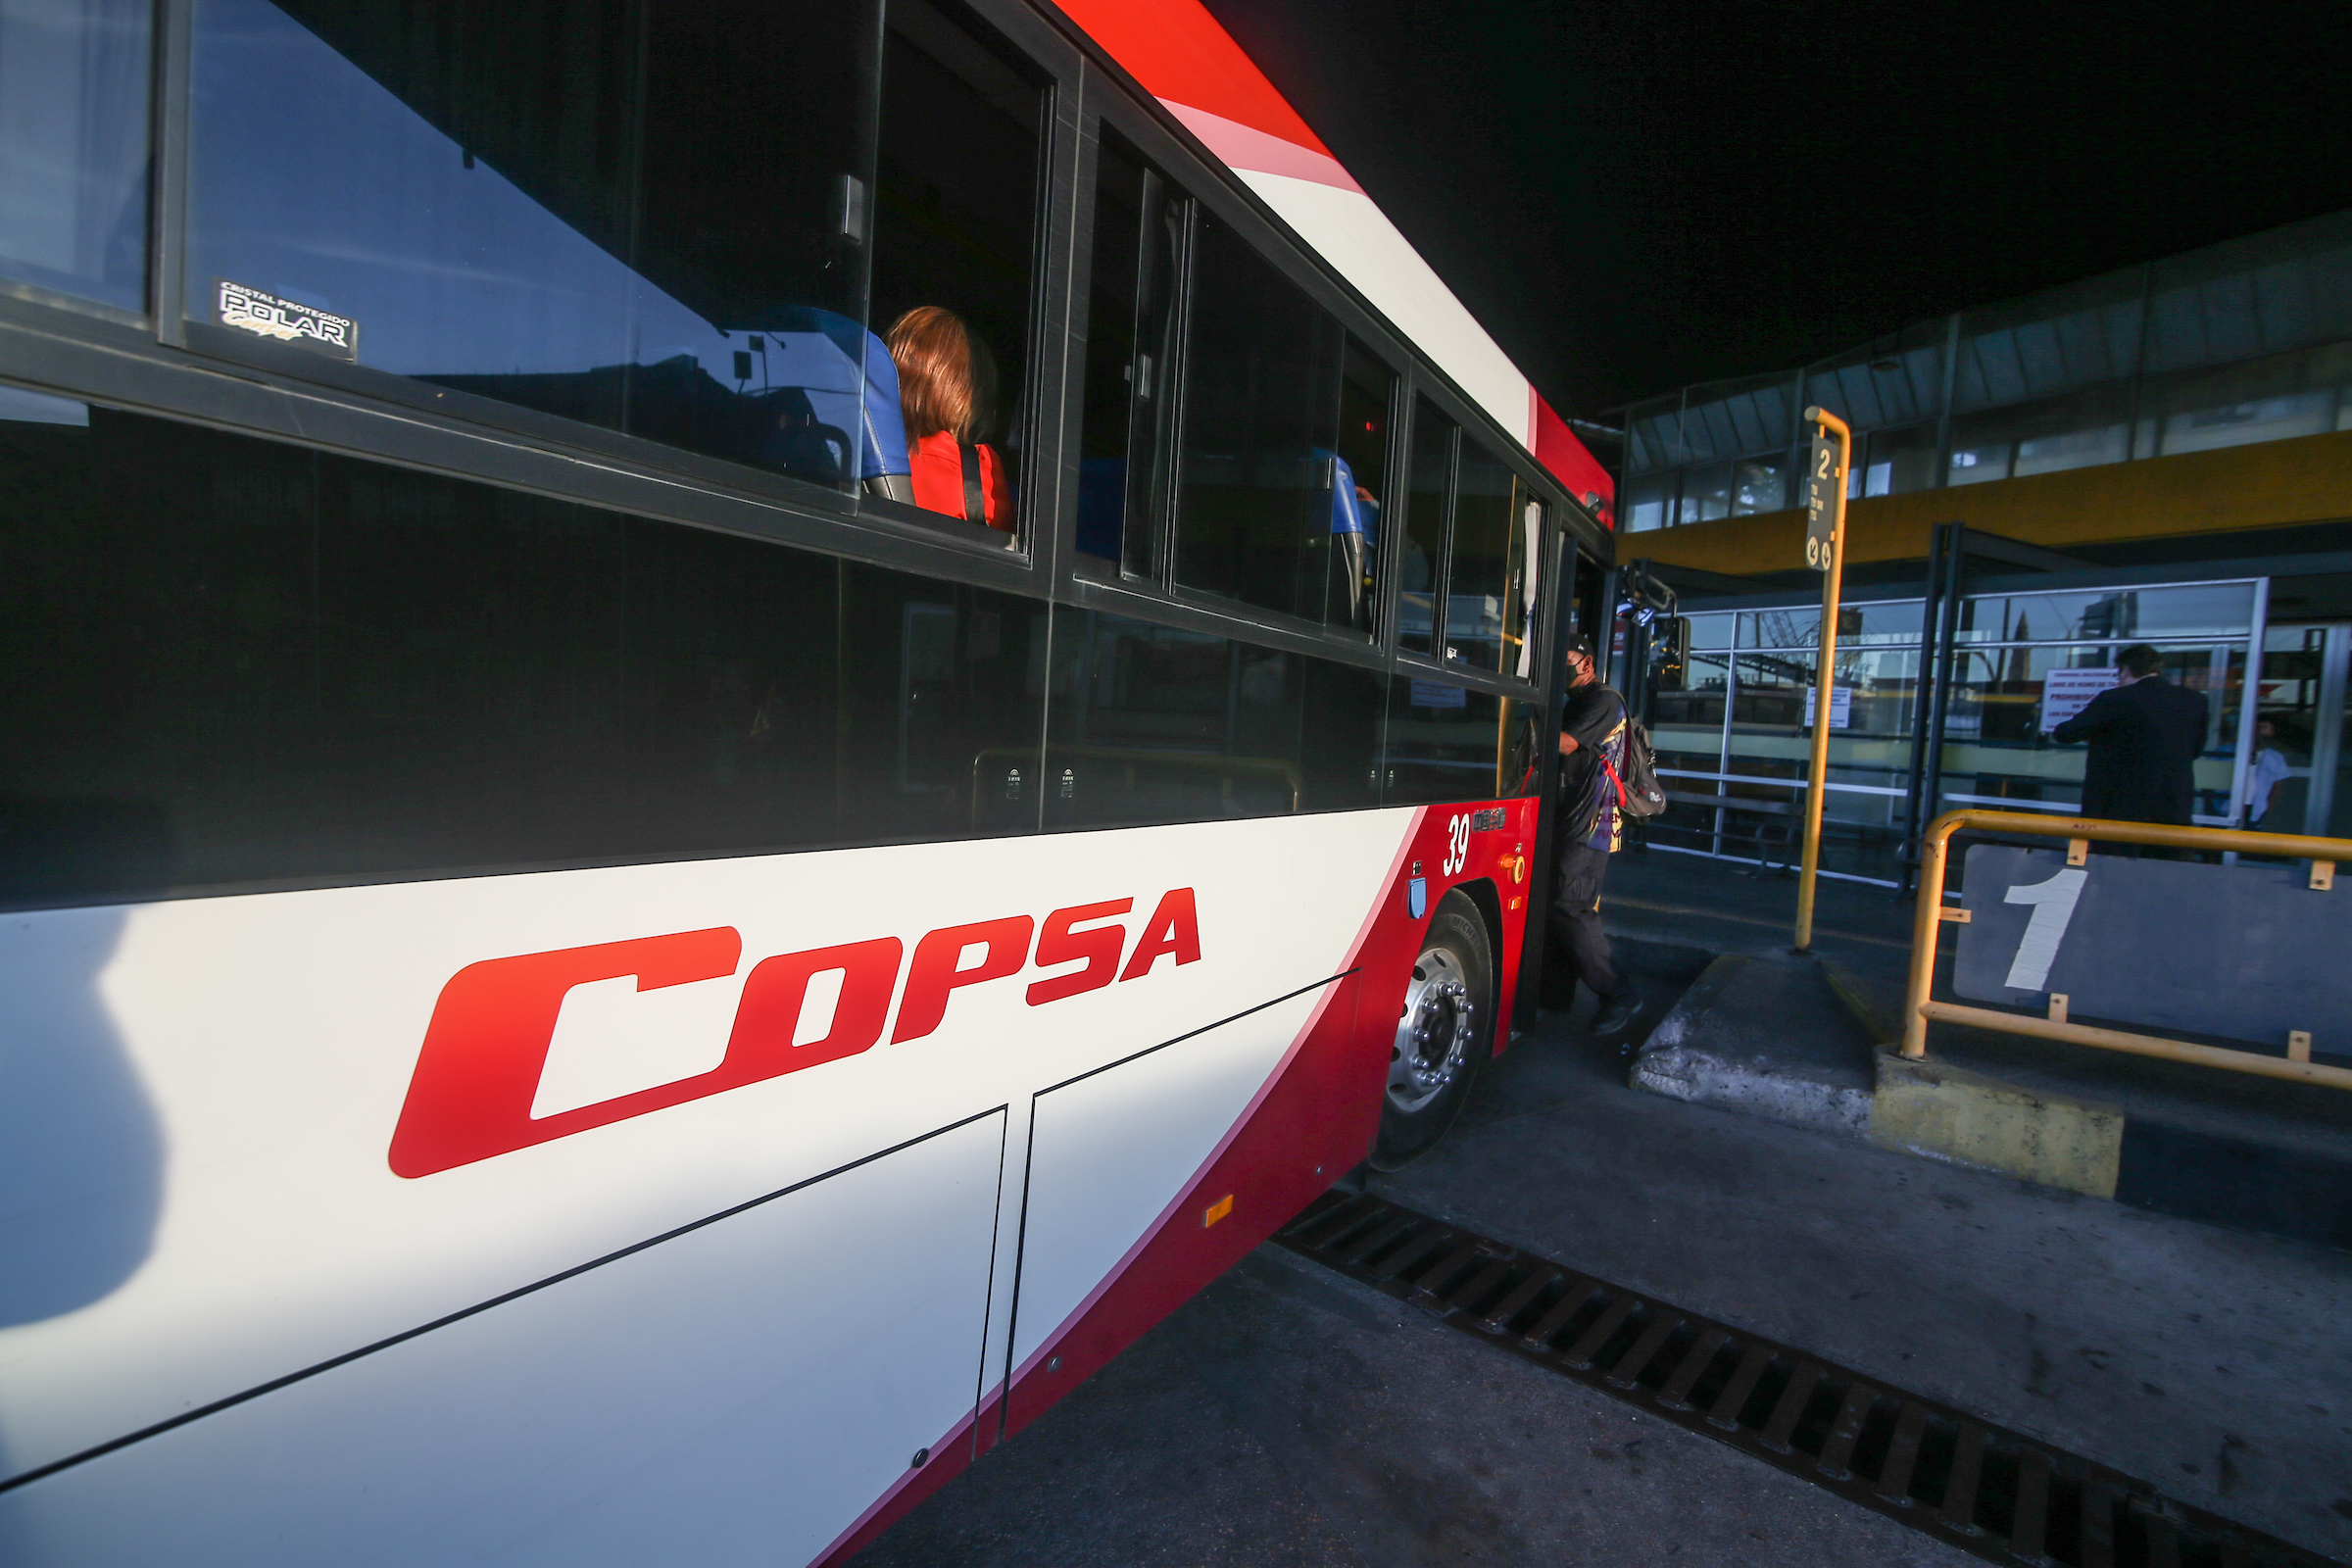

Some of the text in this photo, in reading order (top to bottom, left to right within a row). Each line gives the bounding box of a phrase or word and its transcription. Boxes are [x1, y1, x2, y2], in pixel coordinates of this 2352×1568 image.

[220, 281, 350, 326] CRISTAL PROTEGIDO
[220, 288, 348, 348] POLAR
[1817, 448, 1831, 480] 2
[1443, 812, 1471, 878] 39
[2003, 867, 2089, 992] 1
[387, 886, 1202, 1180] COPSA
